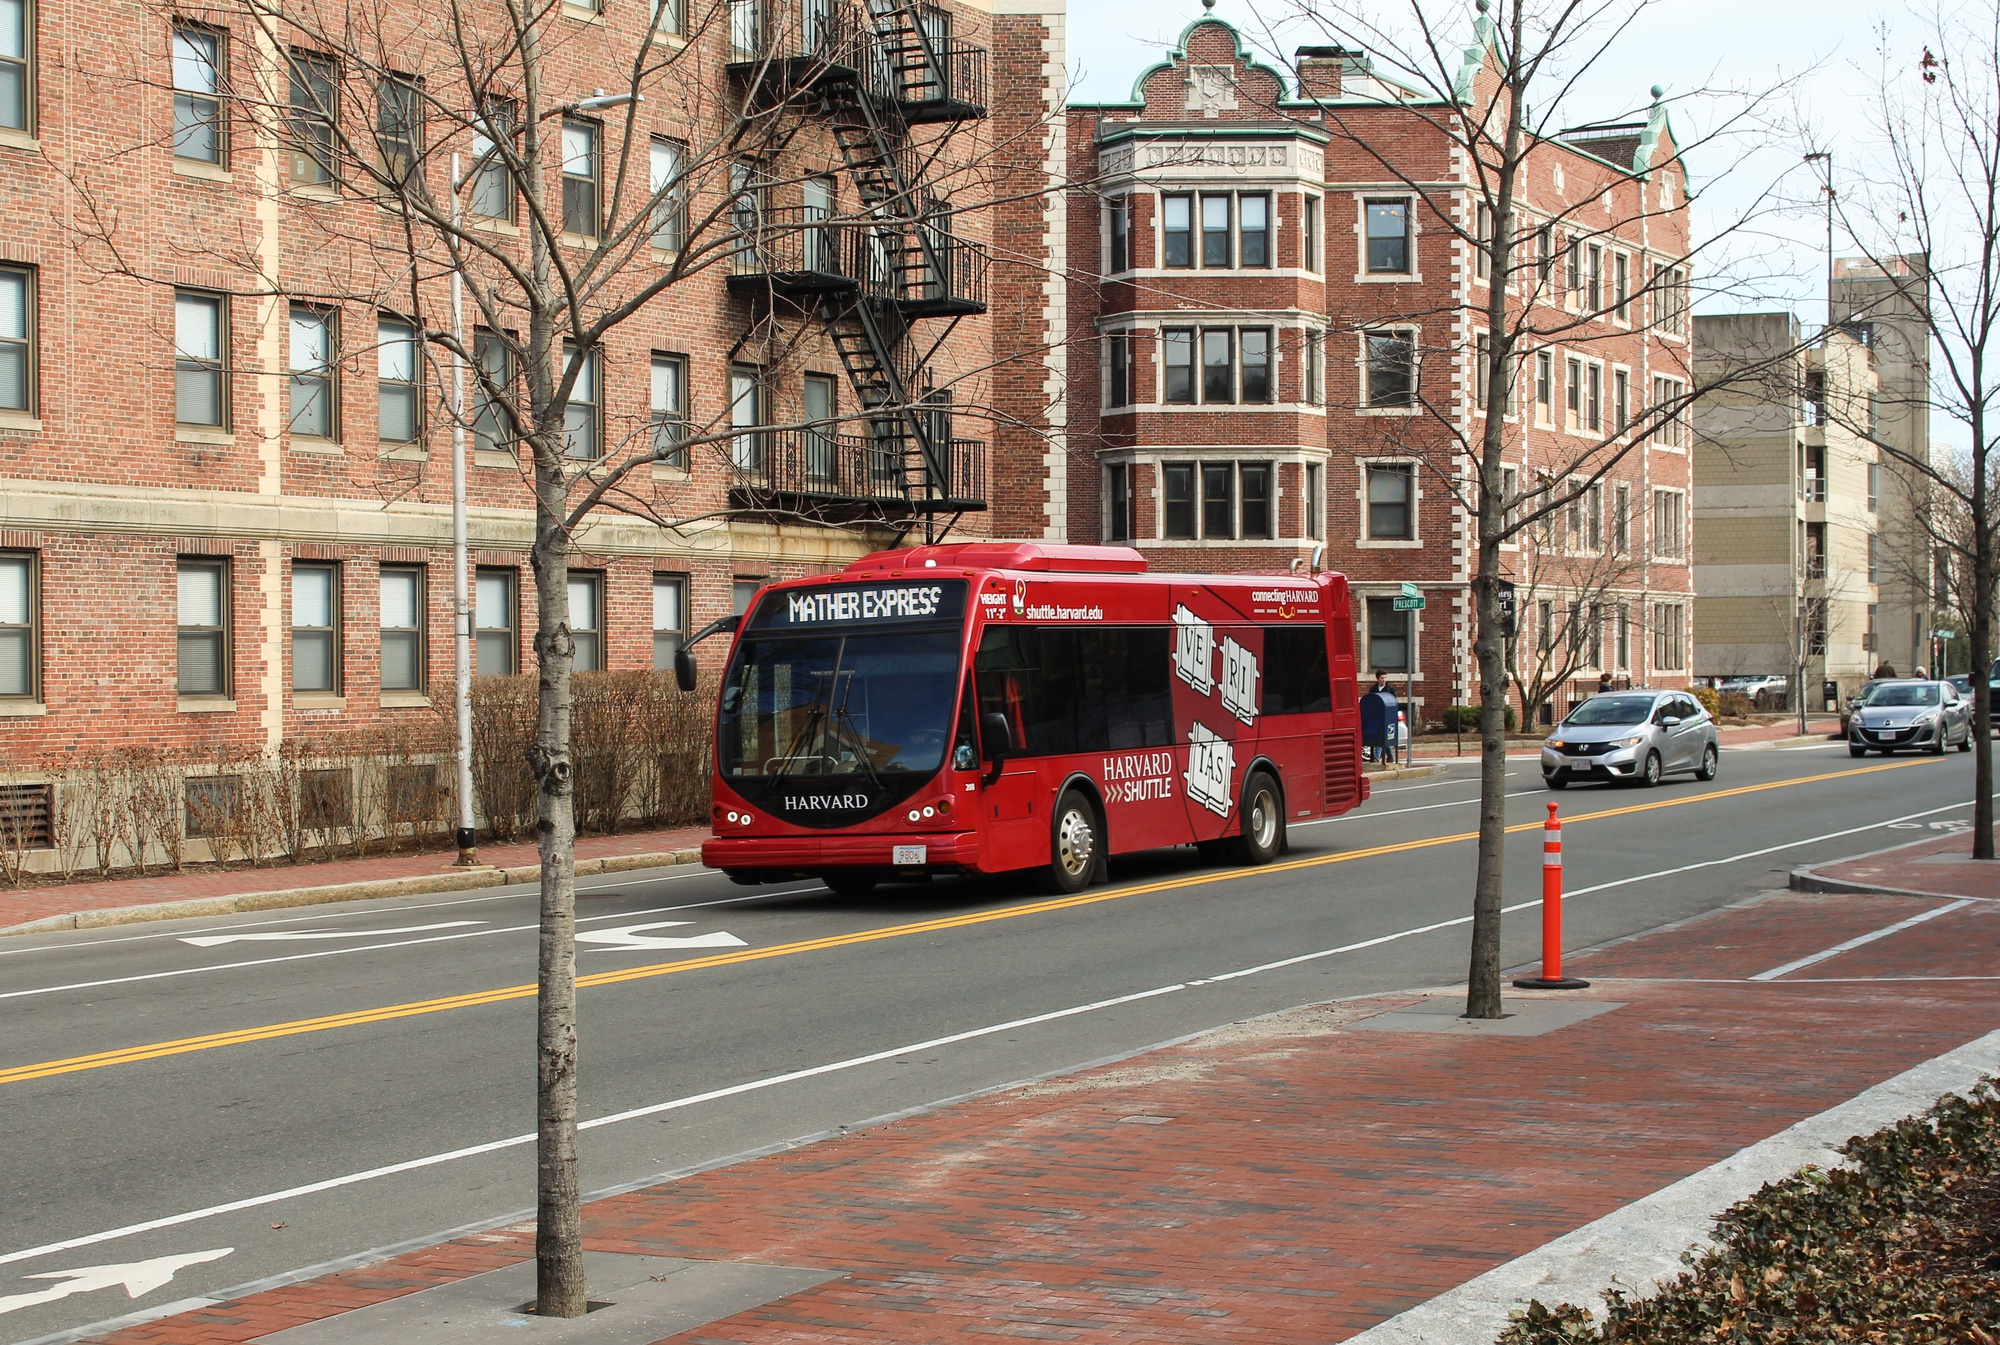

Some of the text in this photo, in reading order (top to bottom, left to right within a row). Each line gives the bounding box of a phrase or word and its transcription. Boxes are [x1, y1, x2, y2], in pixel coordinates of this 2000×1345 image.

[789, 586, 943, 623] MATHER EXPRESS
[980, 593, 1007, 605] HEIGHT
[1395, 599, 1418, 609] PRESCOTT
[1026, 604, 1103, 620] shuttle.harvard.edu
[1103, 752, 1172, 781] HARVARD
[1199, 742, 1224, 785] TAS
[1123, 777, 1172, 803] SHUTTLE
[784, 794, 869, 810] HARVARD
[899, 850, 920, 860] 9806
